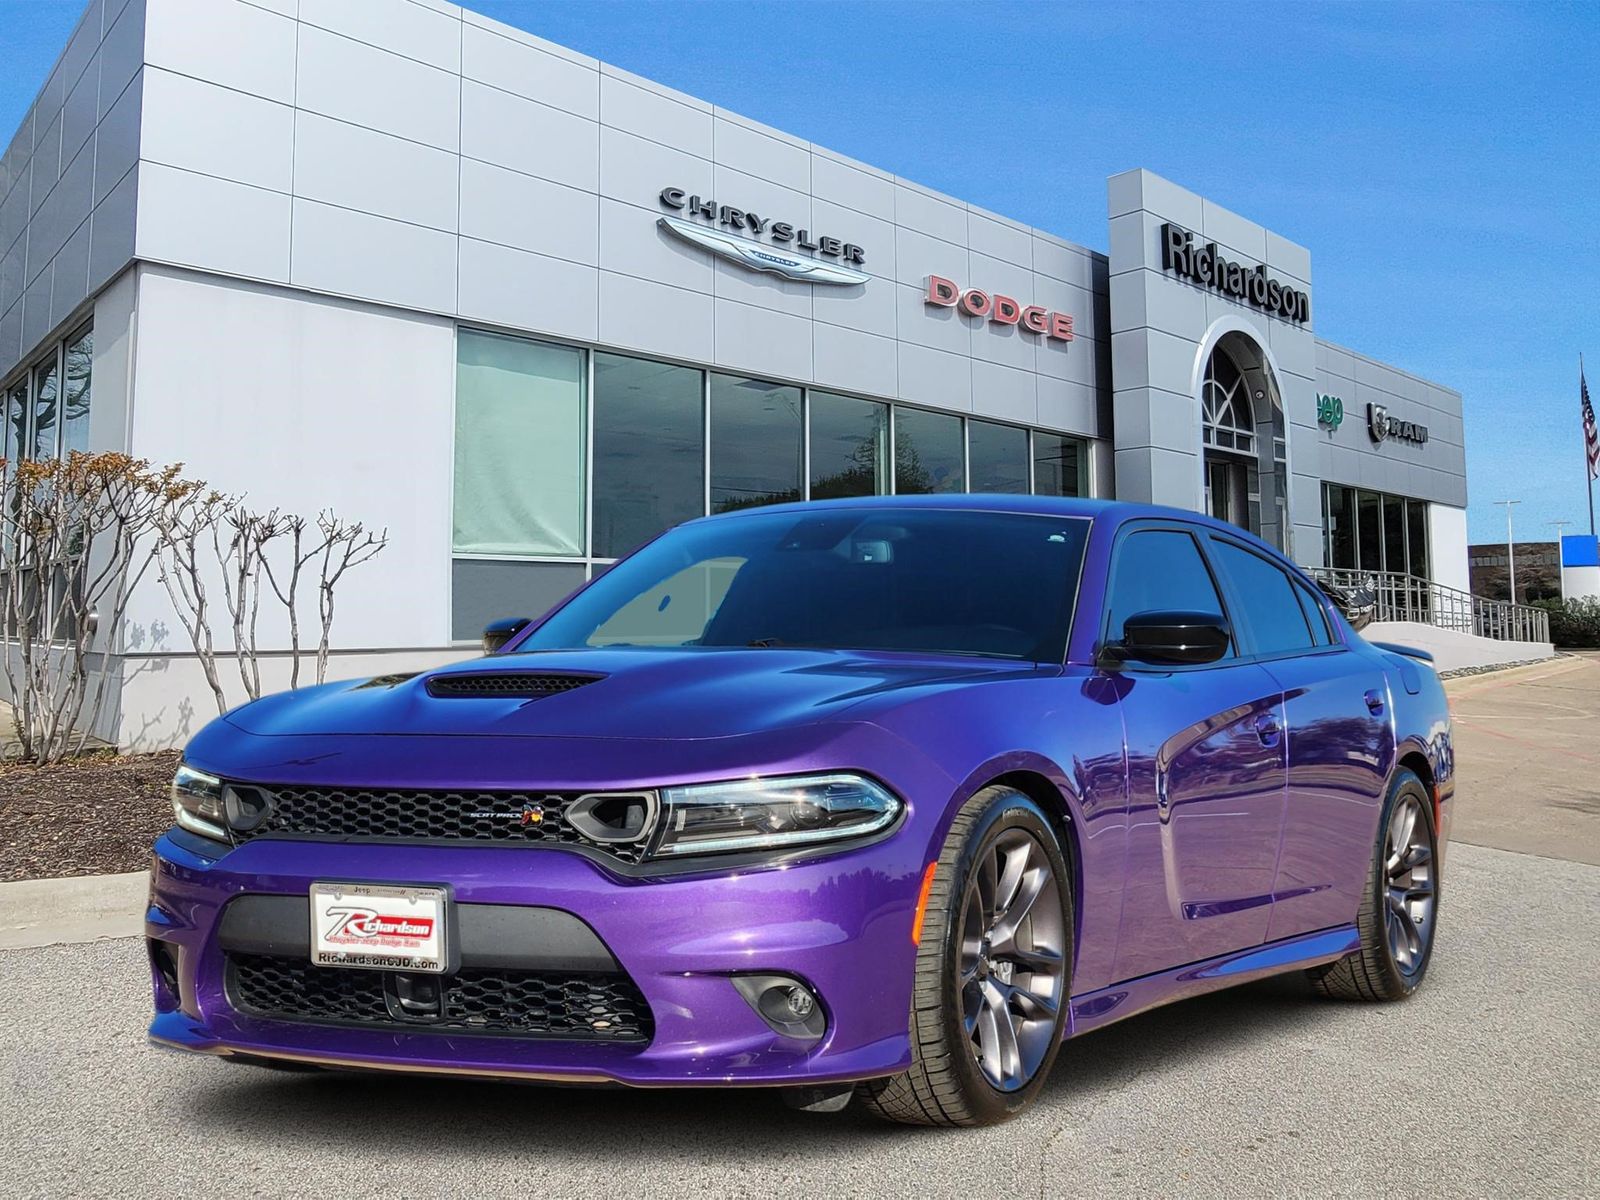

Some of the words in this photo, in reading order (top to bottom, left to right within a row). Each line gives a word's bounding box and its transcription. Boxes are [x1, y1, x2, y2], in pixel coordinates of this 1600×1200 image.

[659, 187, 865, 264] CHRYSLER
[1161, 223, 1309, 323] Richardson
[923, 274, 1074, 342] DODGE
[1386, 416, 1428, 443] RAM
[354, 885, 371, 894] Jeep
[326, 906, 430, 941] Richardson
